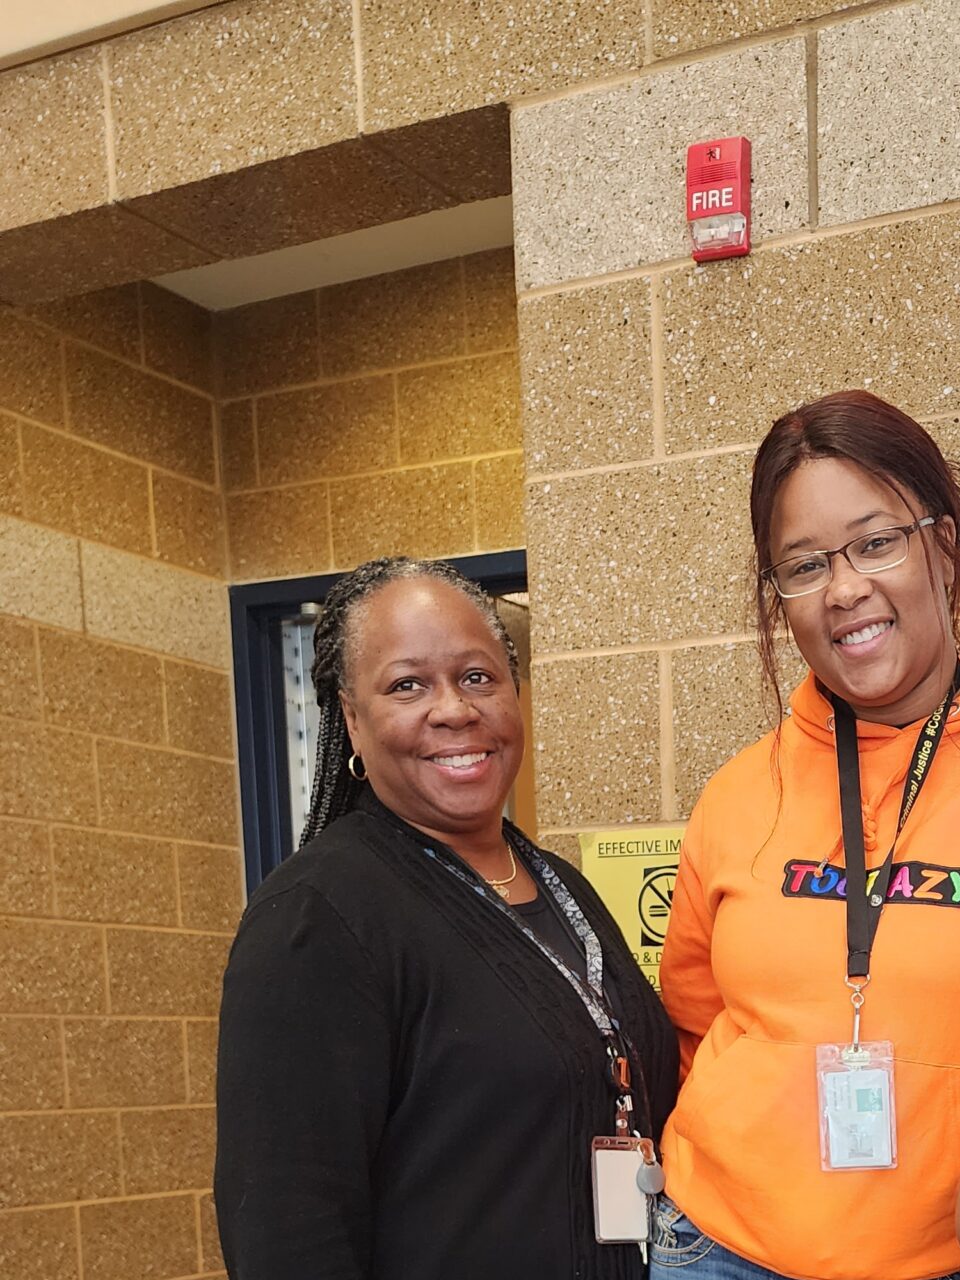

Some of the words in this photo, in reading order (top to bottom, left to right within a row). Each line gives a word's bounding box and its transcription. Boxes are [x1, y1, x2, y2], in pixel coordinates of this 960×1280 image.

[692, 188, 733, 211] FIRE
[913, 740, 933, 780] Justice
[598, 840, 661, 855] EFFECTIVE
